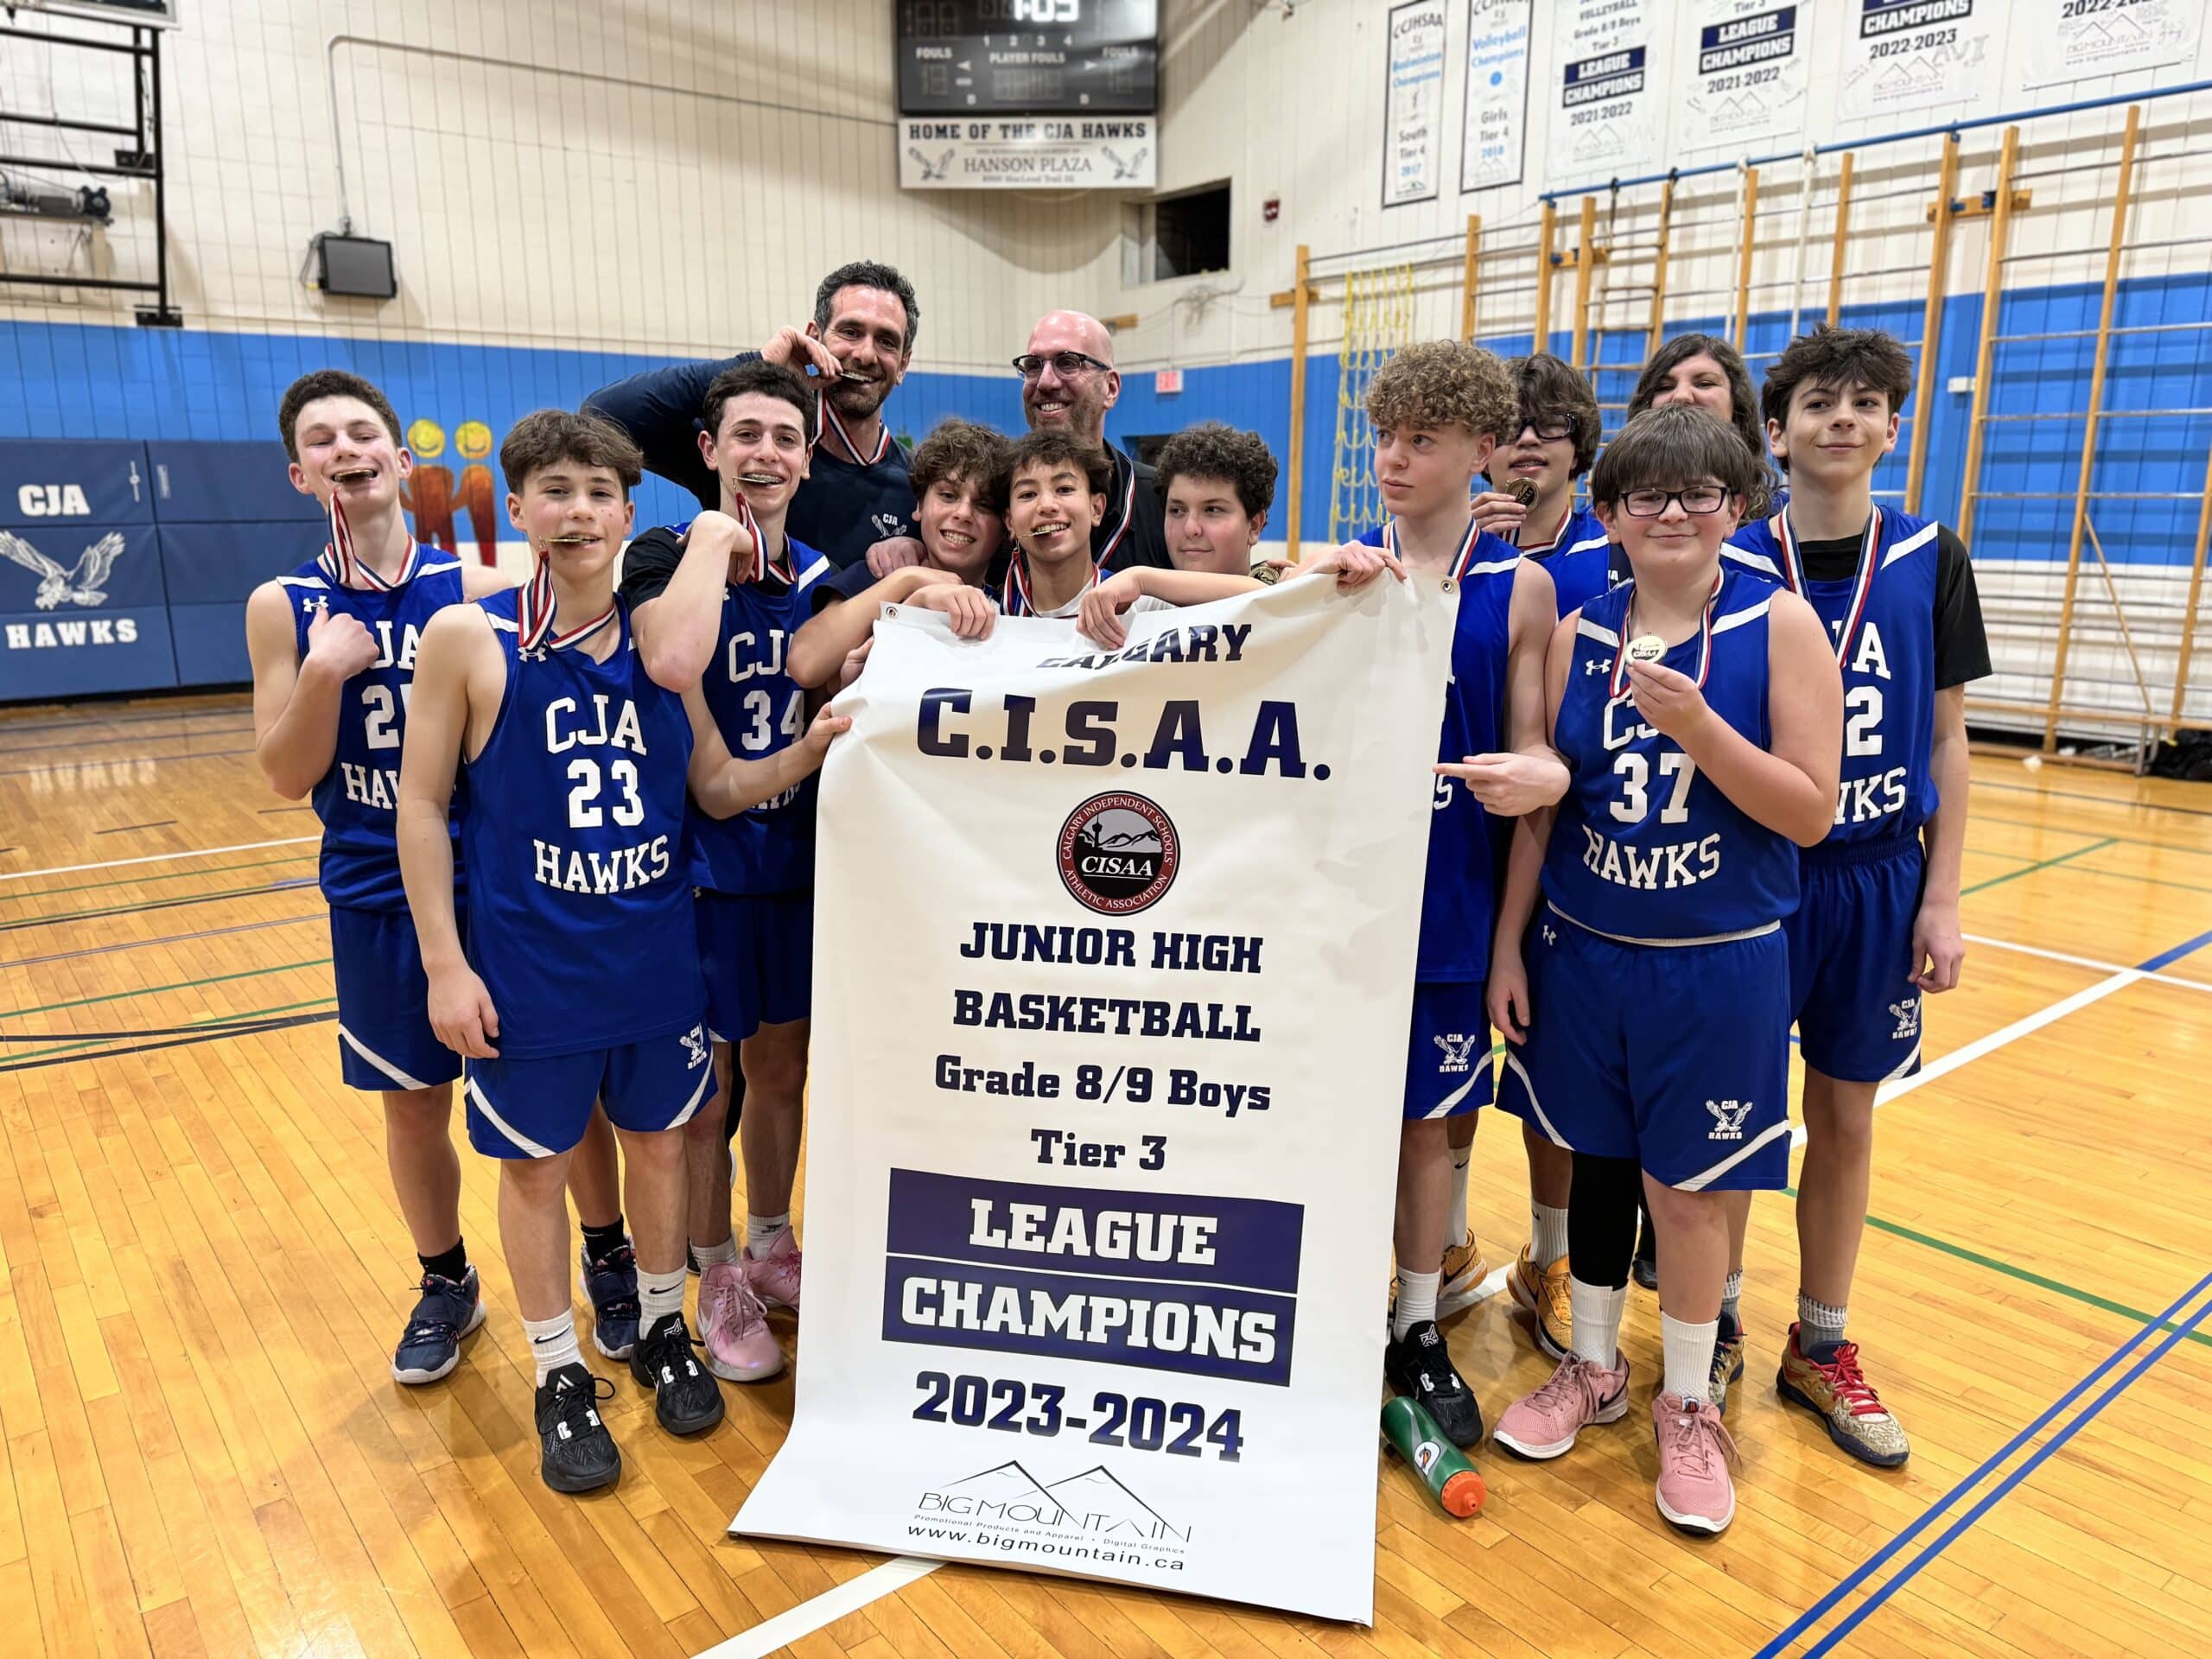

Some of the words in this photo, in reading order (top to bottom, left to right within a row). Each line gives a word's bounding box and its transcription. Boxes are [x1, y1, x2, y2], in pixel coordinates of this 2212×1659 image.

[1718, 14, 1778, 43] LEAGUE
[1864, 0, 1970, 35] CHAMPIONS
[916, 47, 952, 60] FOULS
[988, 52, 1029, 64] PLAYER
[1031, 52, 1065, 65] FOULS
[1471, 48, 1524, 69] Champions
[1578, 52, 1631, 79] LEAGUE
[1701, 36, 1791, 72] CHAMPIONS
[1565, 73, 1643, 104] CHAMPIONS
[909, 124, 961, 139] HOME
[969, 124, 991, 139] OF
[999, 124, 1036, 138] THE
[1044, 124, 1073, 138] CJA
[1082, 123, 1146, 138] HAWKS
[1399, 127, 1427, 143] South
[1481, 108, 1507, 124] Girls
[1400, 148, 1416, 159] Tier
[1480, 130, 1499, 142] Tier
[963, 158, 1035, 173] HANSON
[1040, 157, 1092, 172] PLAZA
[17, 485, 91, 517] CJA
[882, 513, 899, 526] CJA
[5, 619, 138, 649] HAWKS
[369, 620, 422, 671] JA
[728, 629, 794, 683] CJ
[545, 694, 647, 756] CJA
[741, 690, 804, 751] 34
[918, 688, 1331, 781] C.I.S.A.A.
[567, 759, 645, 828] 23
[1610, 753, 1696, 823] 37
[1063, 815, 1084, 860] CALGARY
[1084, 798, 1155, 817] INDEPENDENT
[533, 835, 670, 894] HAWKS
[1081, 856, 1154, 876] CISAA
[1582, 823, 1721, 890] HAWKS
[1064, 869, 1104, 906] ATHLETIC
[1105, 874, 1168, 909] ASSOCIATION
[960, 921, 1136, 967] JUNIOR
[1150, 931, 1264, 974] HIGH
[953, 989, 1261, 1042] BASKETBALL
[1446, 1033, 1464, 1043] CJA
[935, 1054, 1060, 1098] Grade
[1076, 1065, 1154, 1104] 8/9
[1167, 1069, 1271, 1118] Boys
[1721, 1100, 1738, 1110] CJA
[1031, 1128, 1125, 1168] Tier
[1139, 1135, 1167, 1171] 3
[969, 1198, 1218, 1266] LEAGUE
[901, 1276, 1277, 1363] CHAMPIONS
[912, 1370, 1244, 1463] 2023-2024
[908, 1526, 1184, 1571] www.bigmountain.ca
[914, 1514, 973, 1528] Promotional
[976, 1522, 1020, 1534] Products
[1023, 1528, 1042, 1536] and
[1046, 1531, 1084, 1541] Apparel
[1103, 1538, 1137, 1548] Digital
[1141, 1543, 1185, 1554] Graphics
